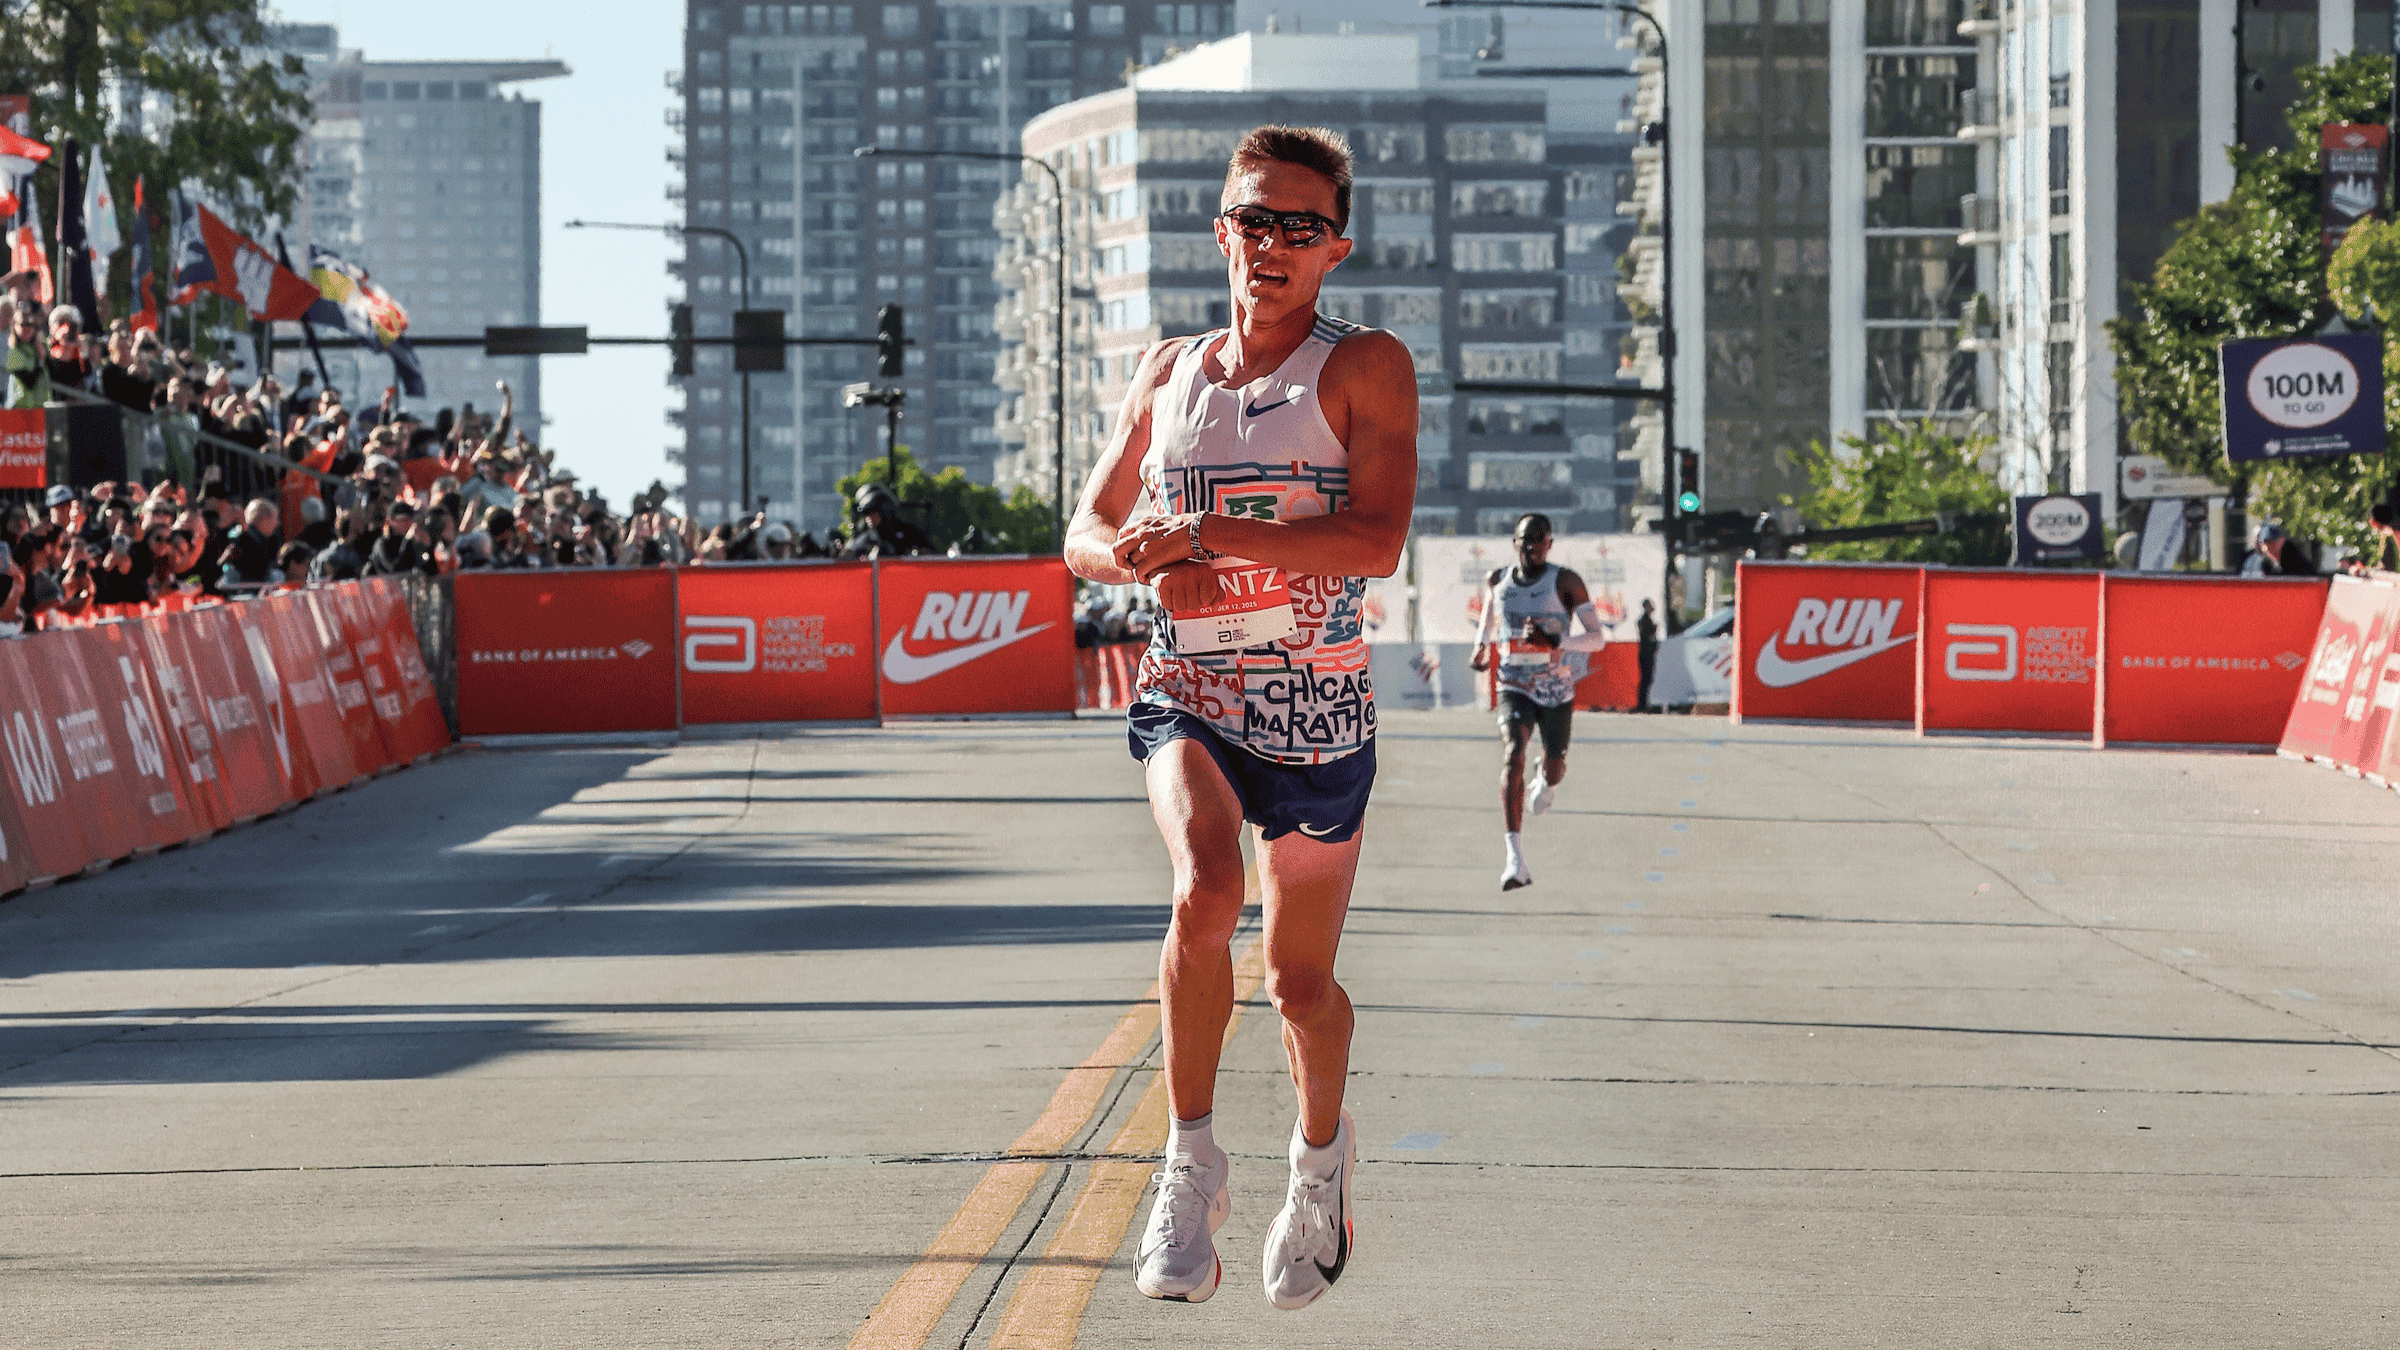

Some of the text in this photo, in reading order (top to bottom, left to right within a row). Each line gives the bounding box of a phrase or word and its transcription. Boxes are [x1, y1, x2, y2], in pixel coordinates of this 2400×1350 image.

[1218, 567, 1283, 597] NTZ
[1200, 604, 1230, 614] OCTER
[1242, 601, 1258, 609] 2025
[911, 590, 1030, 641] RUN
[1785, 597, 1904, 646] RUN
[471, 647, 618, 663] BANK OF AMERICA
[763, 643, 855, 657] MARATHON
[763, 657, 828, 672] MAJORS
[2122, 655, 2270, 670] BANK OF AMERICA
